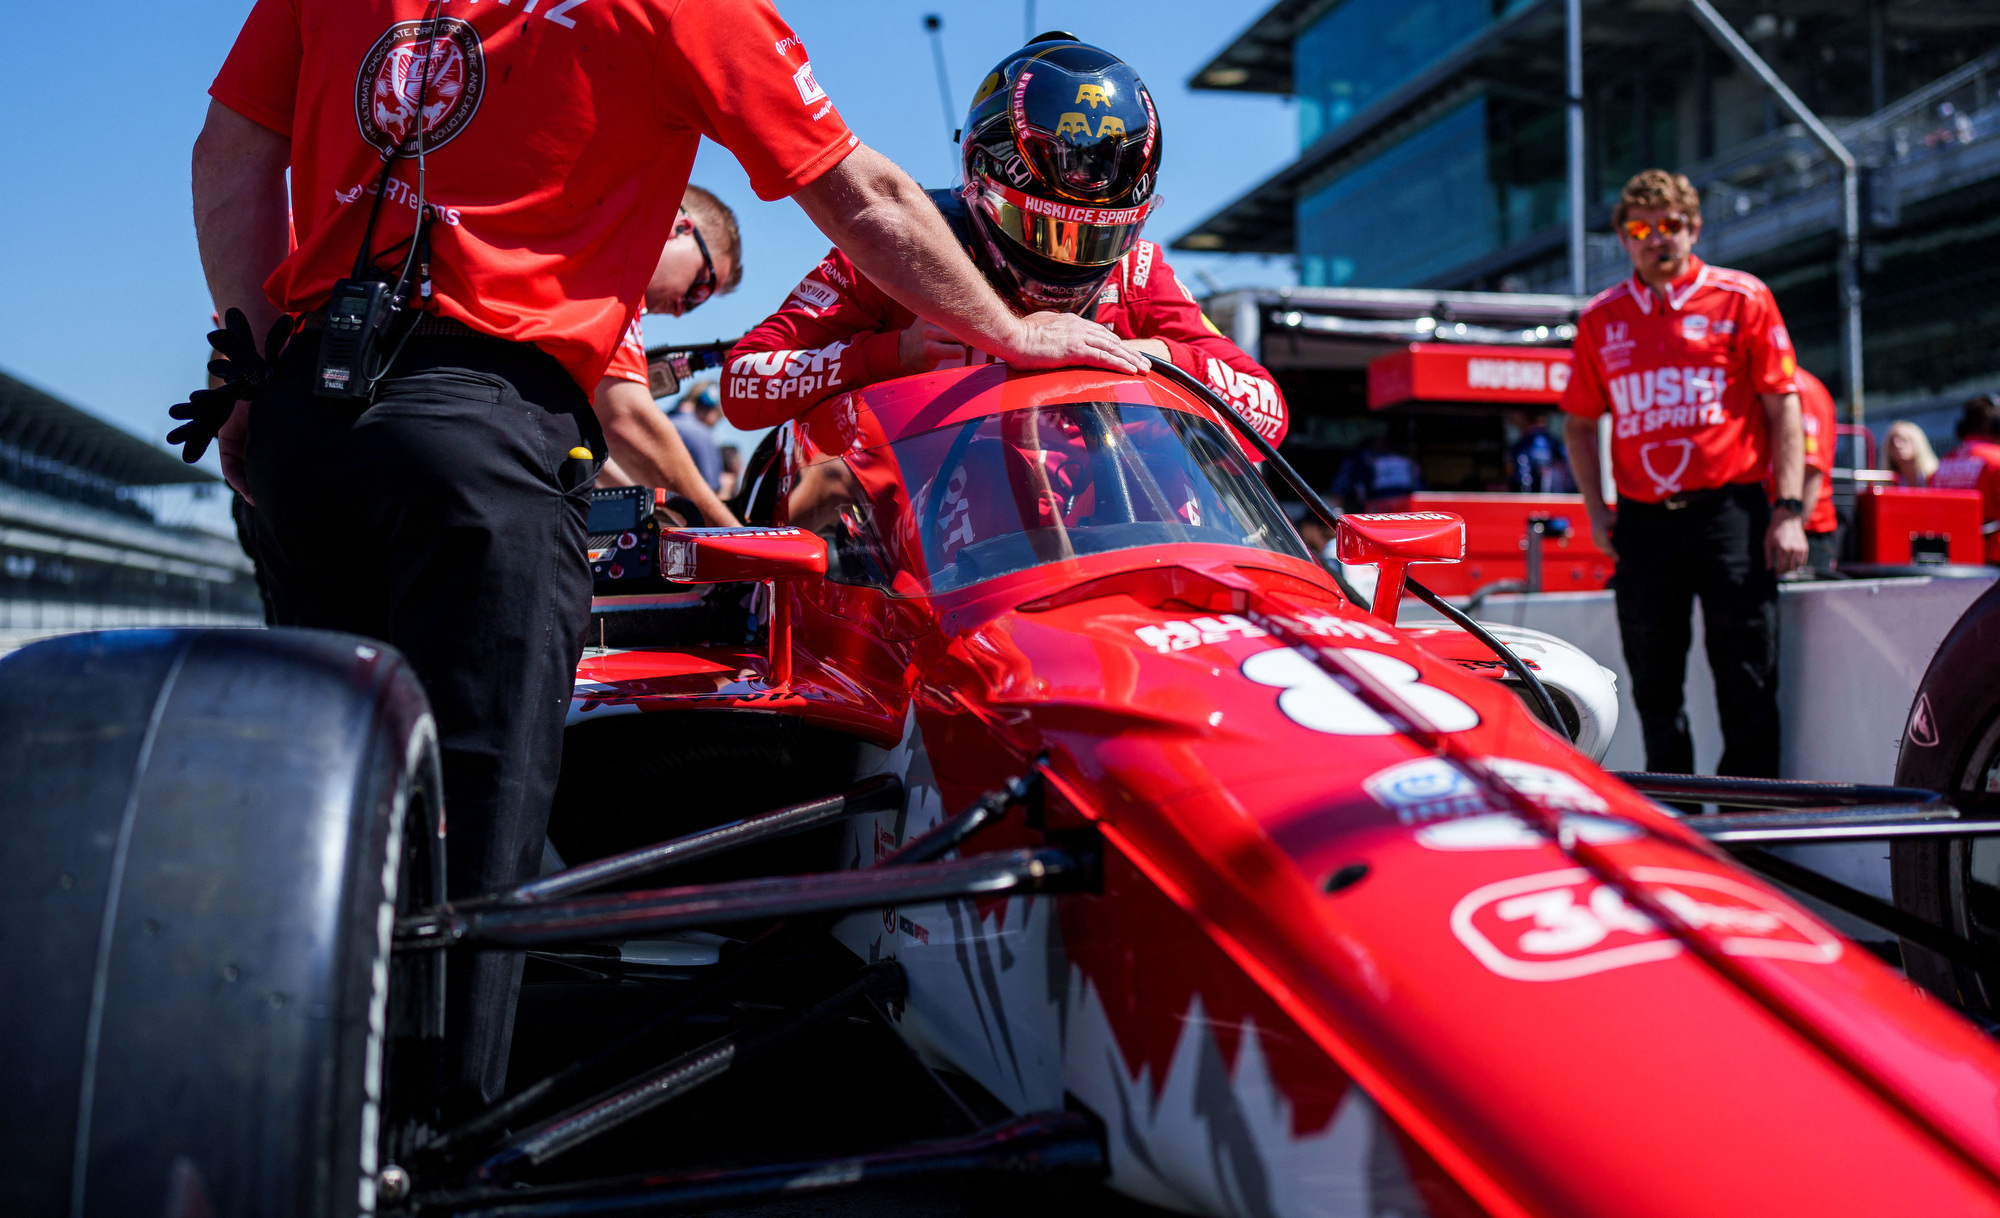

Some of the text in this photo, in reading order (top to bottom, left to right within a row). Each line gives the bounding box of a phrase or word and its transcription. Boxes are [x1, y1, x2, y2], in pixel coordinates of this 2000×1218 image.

[413, 25, 439, 36] DRIN
[367, 28, 412, 74] CHOCOLATE
[361, 75, 372, 122] ULTIMATE
[468, 71, 478, 94] AND
[430, 94, 474, 142] EXPEDITION
[1013, 73, 1033, 139] BAUHAUS
[364, 122, 379, 140] THE
[963, 182, 978, 197] BELL
[1025, 196, 1140, 224] HUSKI ICE SPRITZ
[1133, 240, 1154, 290] sparco
[729, 362, 842, 400] ICE SPRIZ
[1207, 358, 1284, 420] HUSKI
[1608, 366, 1727, 416] HUSKI
[1616, 401, 1726, 439] CE SPRITZ
[662, 540, 698, 566] HUSKI
